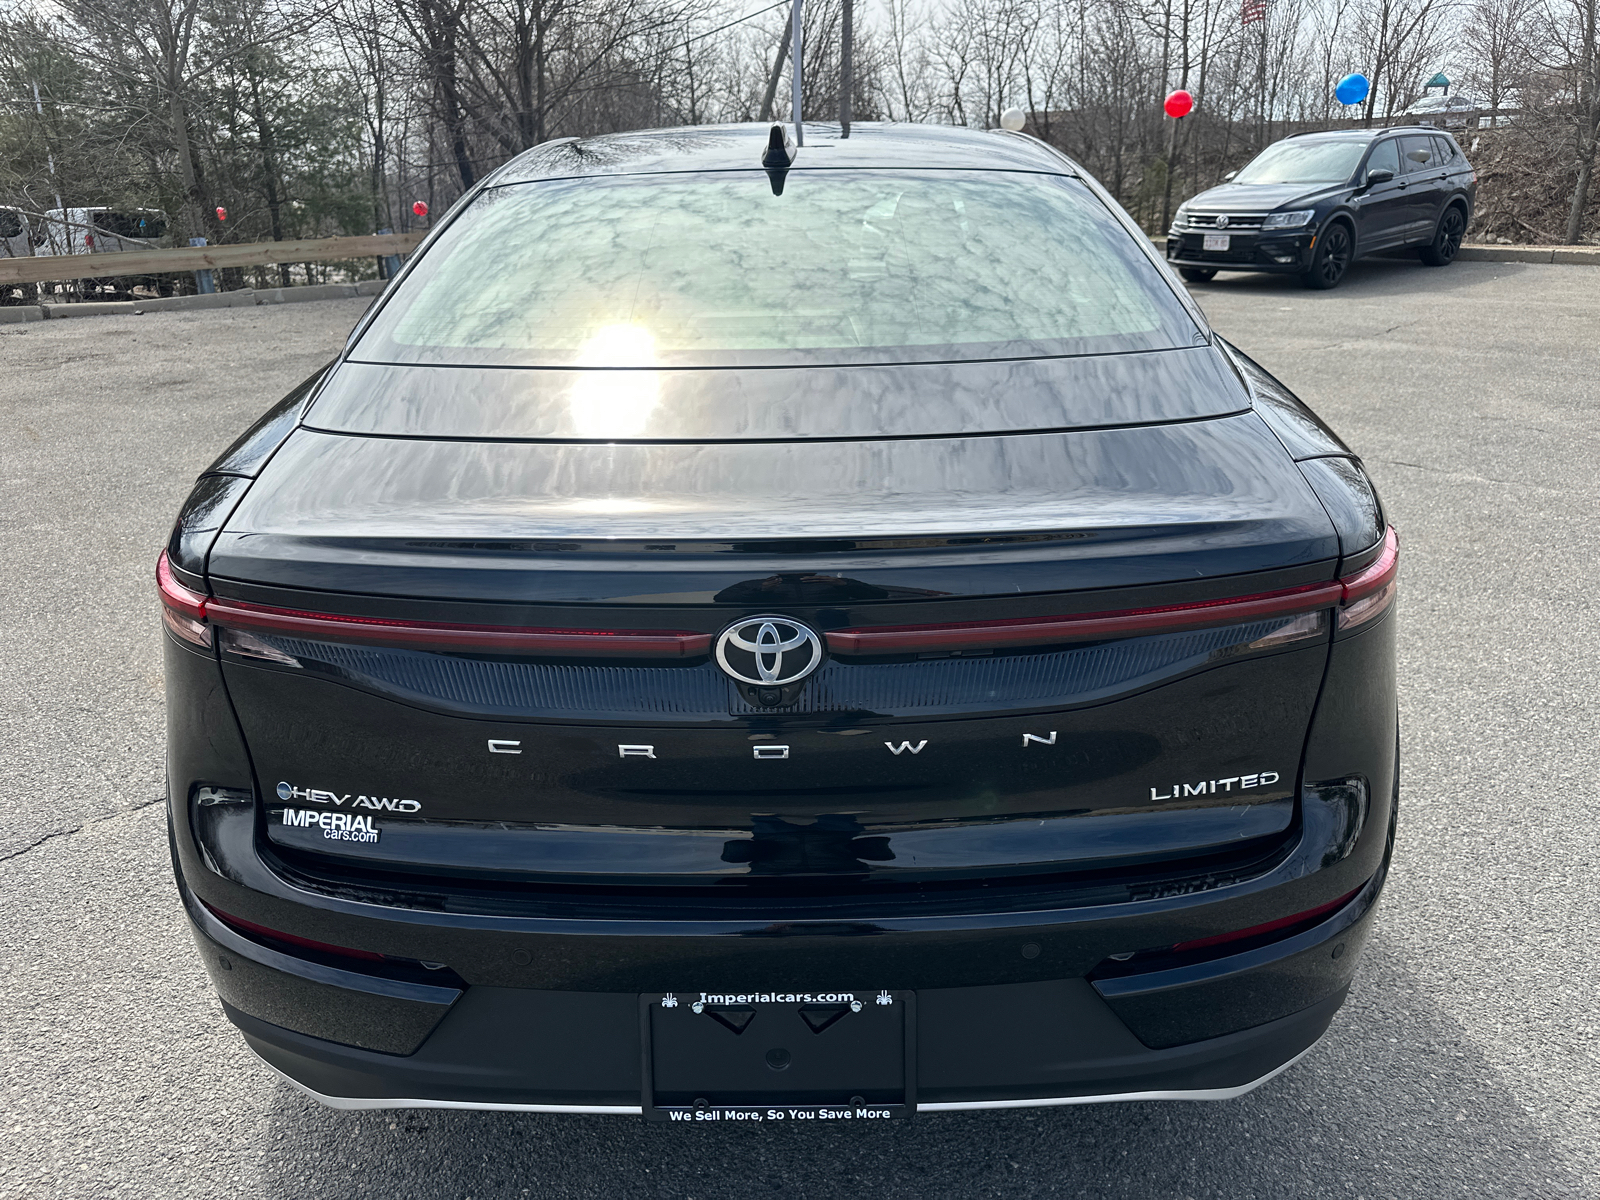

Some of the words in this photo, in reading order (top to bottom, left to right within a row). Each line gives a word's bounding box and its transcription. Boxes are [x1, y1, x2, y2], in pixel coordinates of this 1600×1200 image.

[488, 731, 1057, 760] CROWN
[1150, 770, 1280, 801] LIMITED
[292, 786, 351, 806] HEV
[351, 795, 422, 813] AWD
[282, 808, 379, 834] IMPERIAL
[323, 829, 378, 843] cars.com
[699, 991, 855, 1005] Imperialcars.com
[669, 1110, 692, 1121] We
[695, 1110, 721, 1121] Sell
[724, 1110, 764, 1122] More,
[767, 1109, 785, 1120] So
[788, 1109, 815, 1120] You
[818, 1109, 852, 1119] Save
[855, 1108, 891, 1119] More
